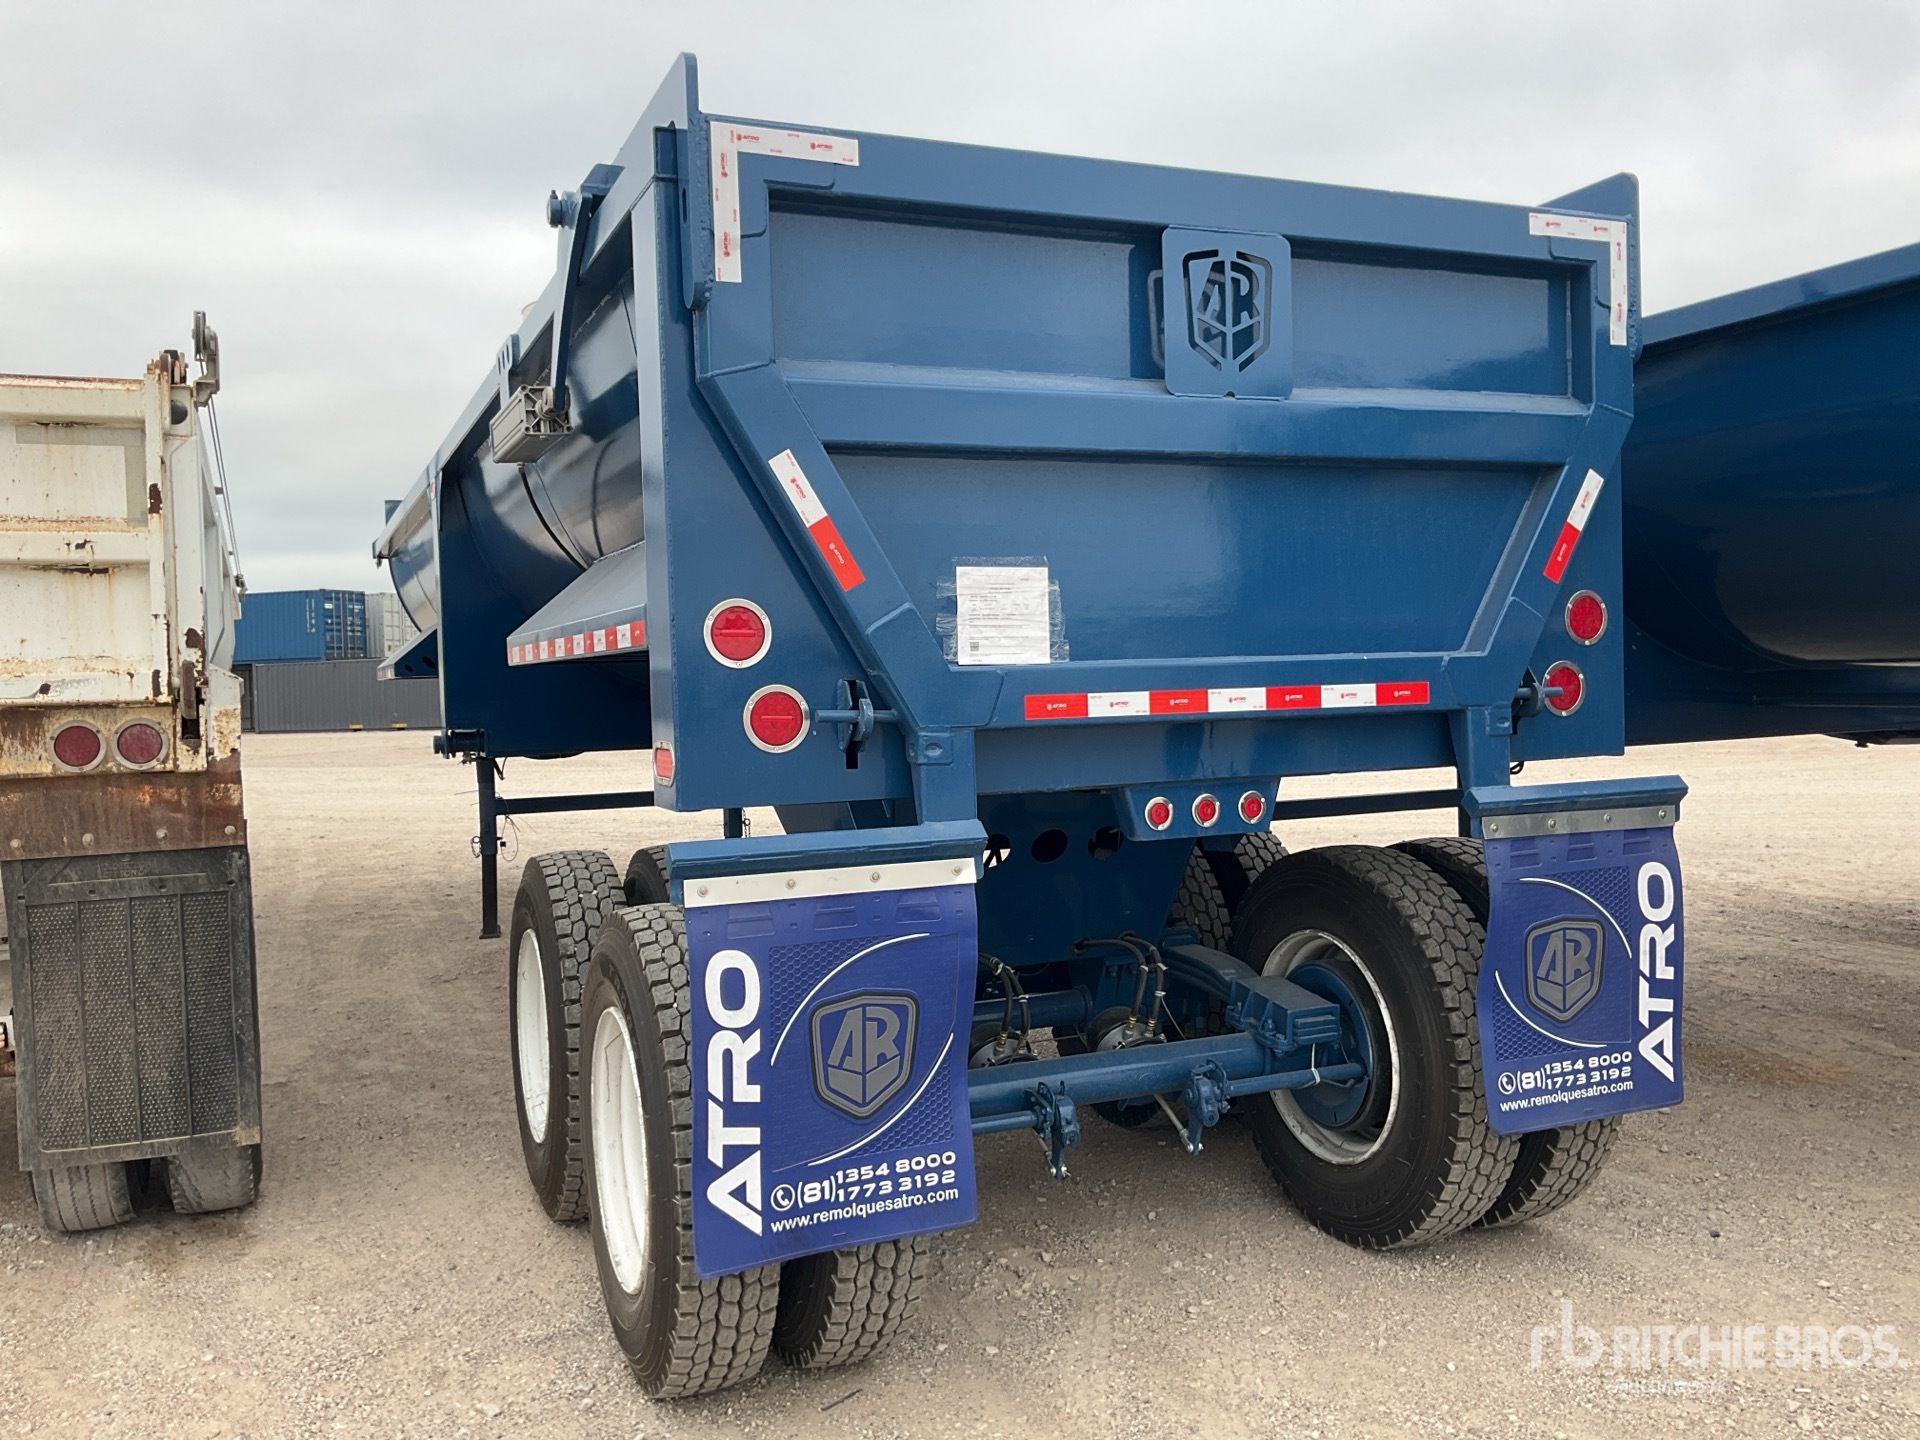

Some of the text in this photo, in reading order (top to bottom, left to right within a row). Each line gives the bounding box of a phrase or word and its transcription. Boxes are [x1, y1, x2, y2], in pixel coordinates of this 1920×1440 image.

[1637, 861, 1675, 1082] ATRO
[704, 949, 763, 1236] ATRO
[1517, 1051, 1633, 1093] (81) 1354 8000
[1546, 1066, 1632, 1090] 1773 3192
[1500, 1080, 1634, 1112] www.remolquesatro.com
[797, 1151, 957, 1209] (81) 1354 8000
[837, 1169, 956, 1202] 1773 3192
[770, 1187, 959, 1233] www.remolquesatro.com
